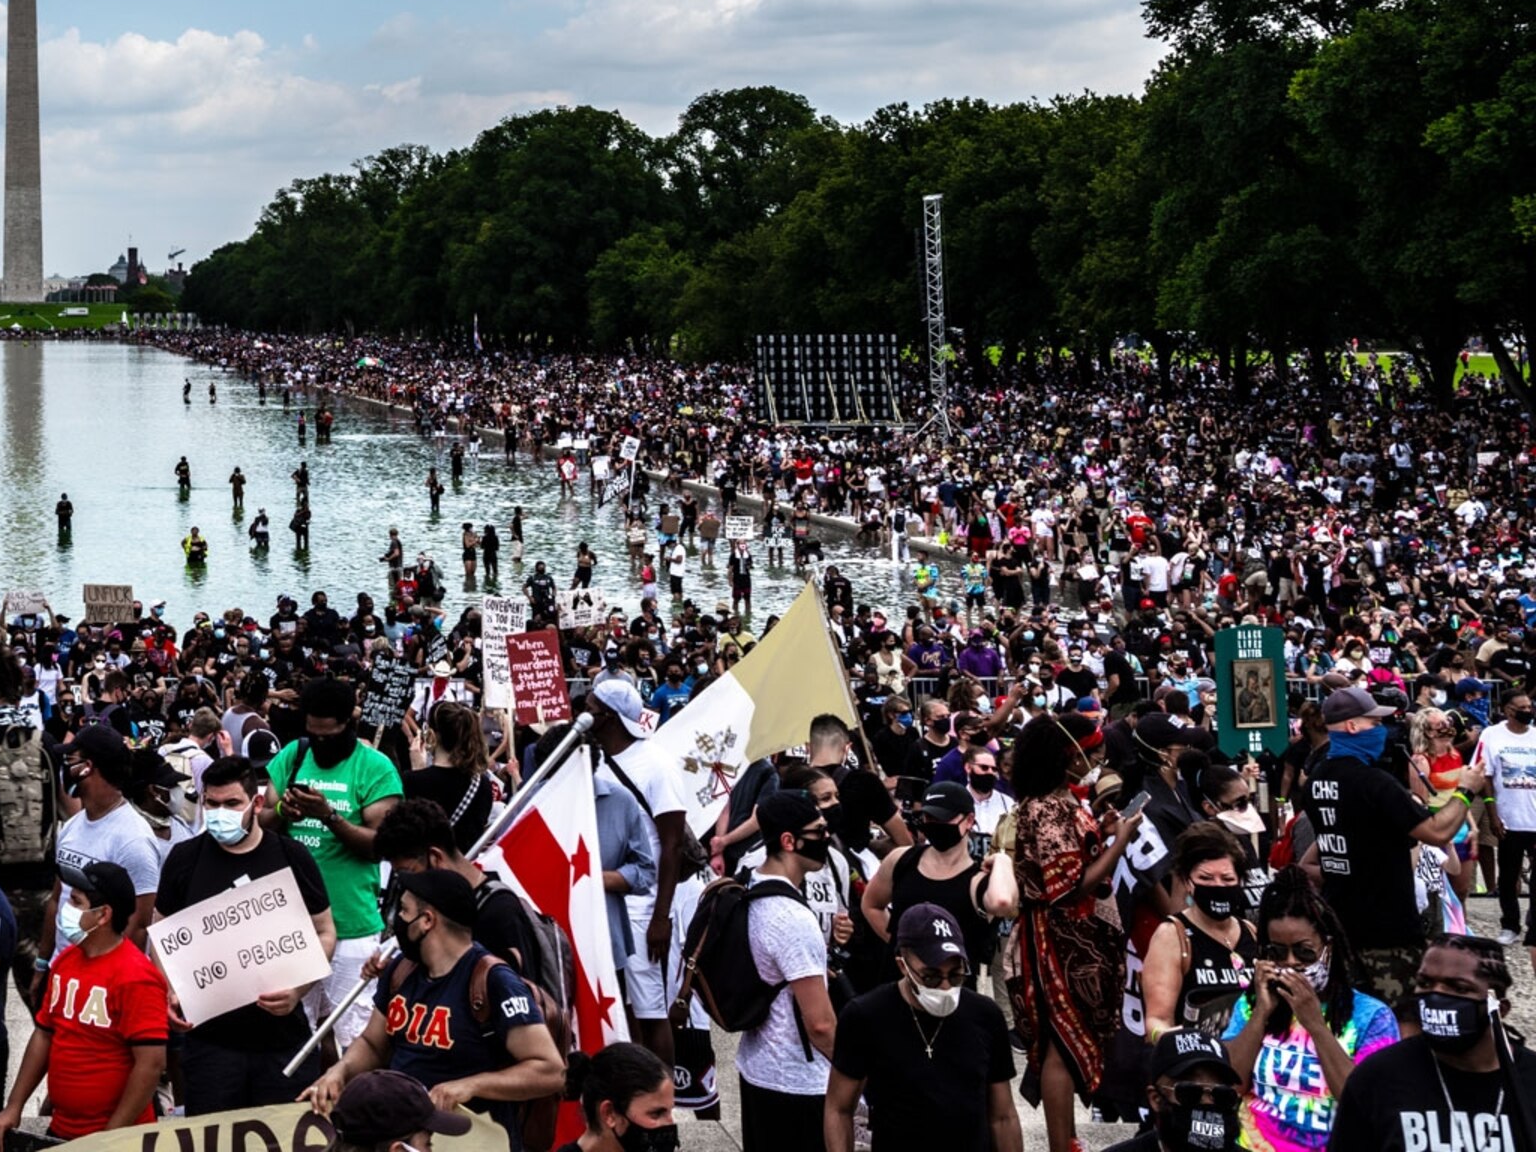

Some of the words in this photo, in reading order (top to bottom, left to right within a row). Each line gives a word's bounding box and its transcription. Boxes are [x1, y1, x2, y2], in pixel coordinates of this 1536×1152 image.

[87, 585, 132, 601] UNFUCK
[1237, 630, 1262, 639] BLACK
[1237, 640, 1262, 649] LIVES
[178, 709, 195, 718] BLA
[57, 849, 83, 866] BLACK
[160, 926, 193, 955] NO
[202, 888, 288, 935] JUSTICE
[193, 961, 228, 989] NO
[238, 930, 308, 969] PEACE
[1196, 967, 1218, 985] NO
[1425, 1007, 1458, 1025] CAN'T
[1191, 1121, 1224, 1138] LIVES
